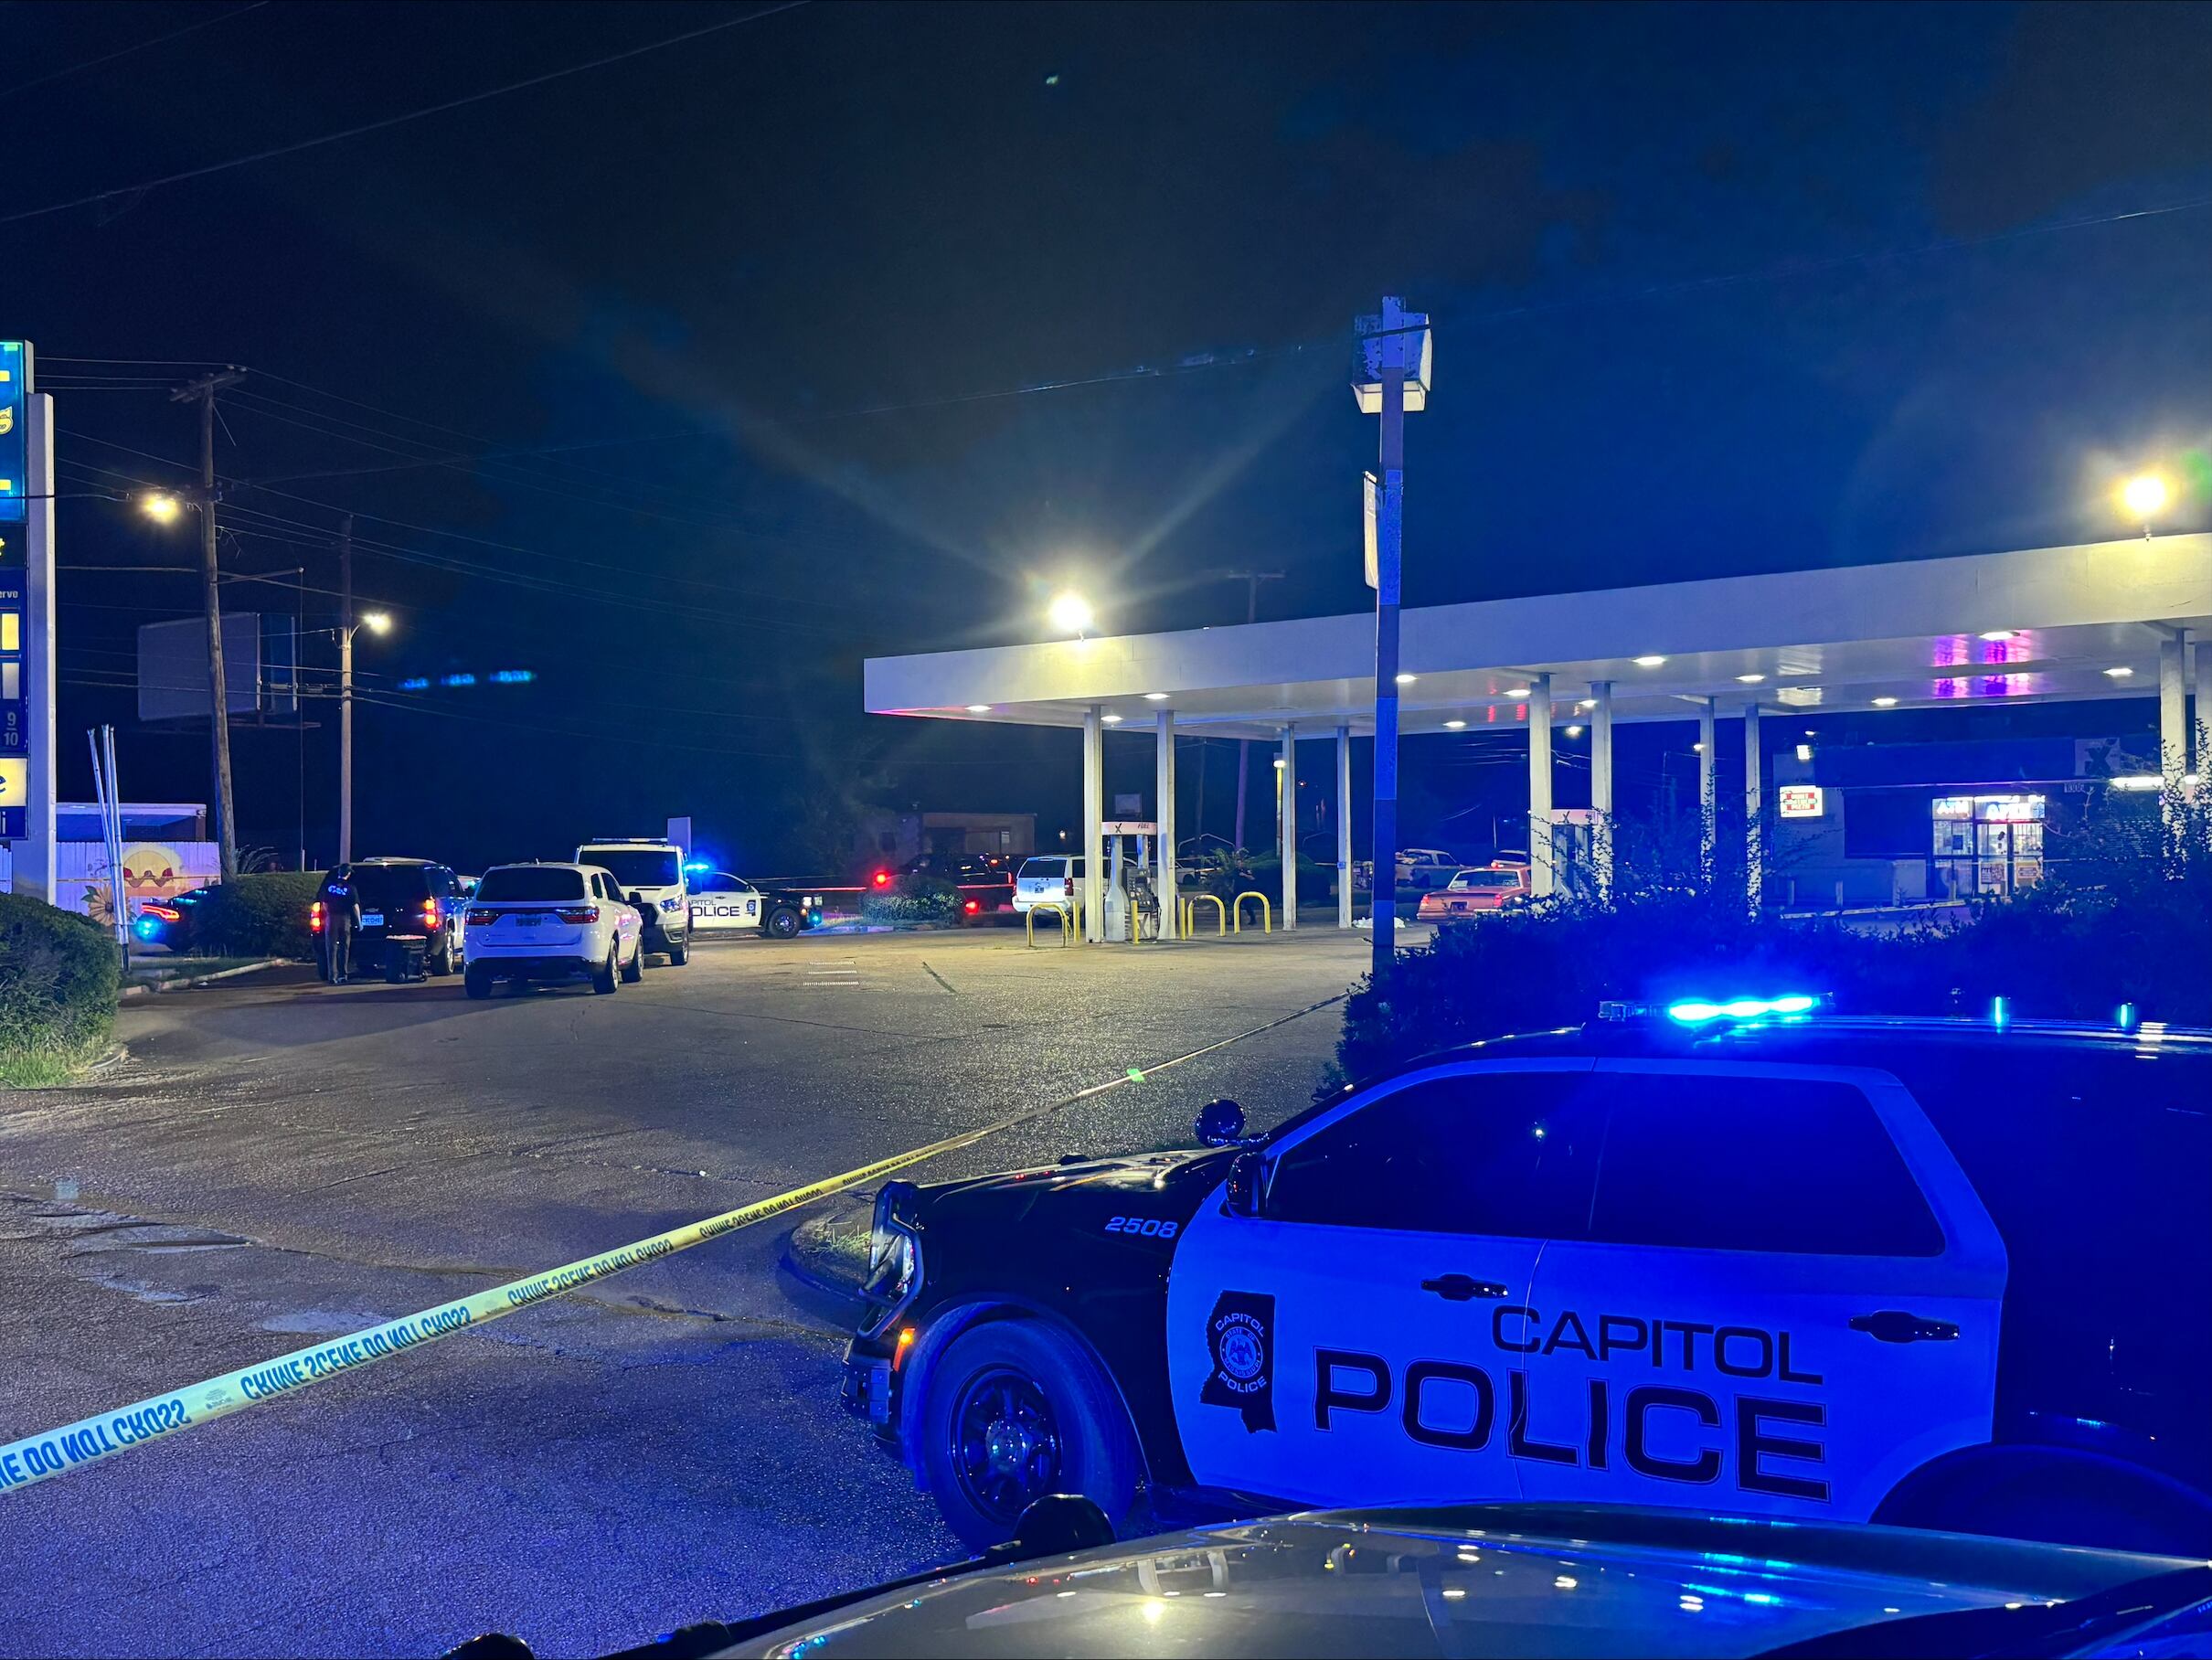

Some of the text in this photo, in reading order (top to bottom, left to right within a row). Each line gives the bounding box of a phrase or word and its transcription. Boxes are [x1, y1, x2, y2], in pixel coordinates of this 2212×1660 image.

[7, 713, 16, 726] 9
[4, 732, 18, 746] 10
[691, 906, 740, 917] OLICE
[1105, 1216, 1178, 1239] 2508
[1215, 1313, 1264, 1337] CAPITOL
[1492, 1304, 1824, 1385] CAPITOL
[1218, 1370, 1267, 1393] POLICE
[1313, 1346, 1831, 1505] POLICE
